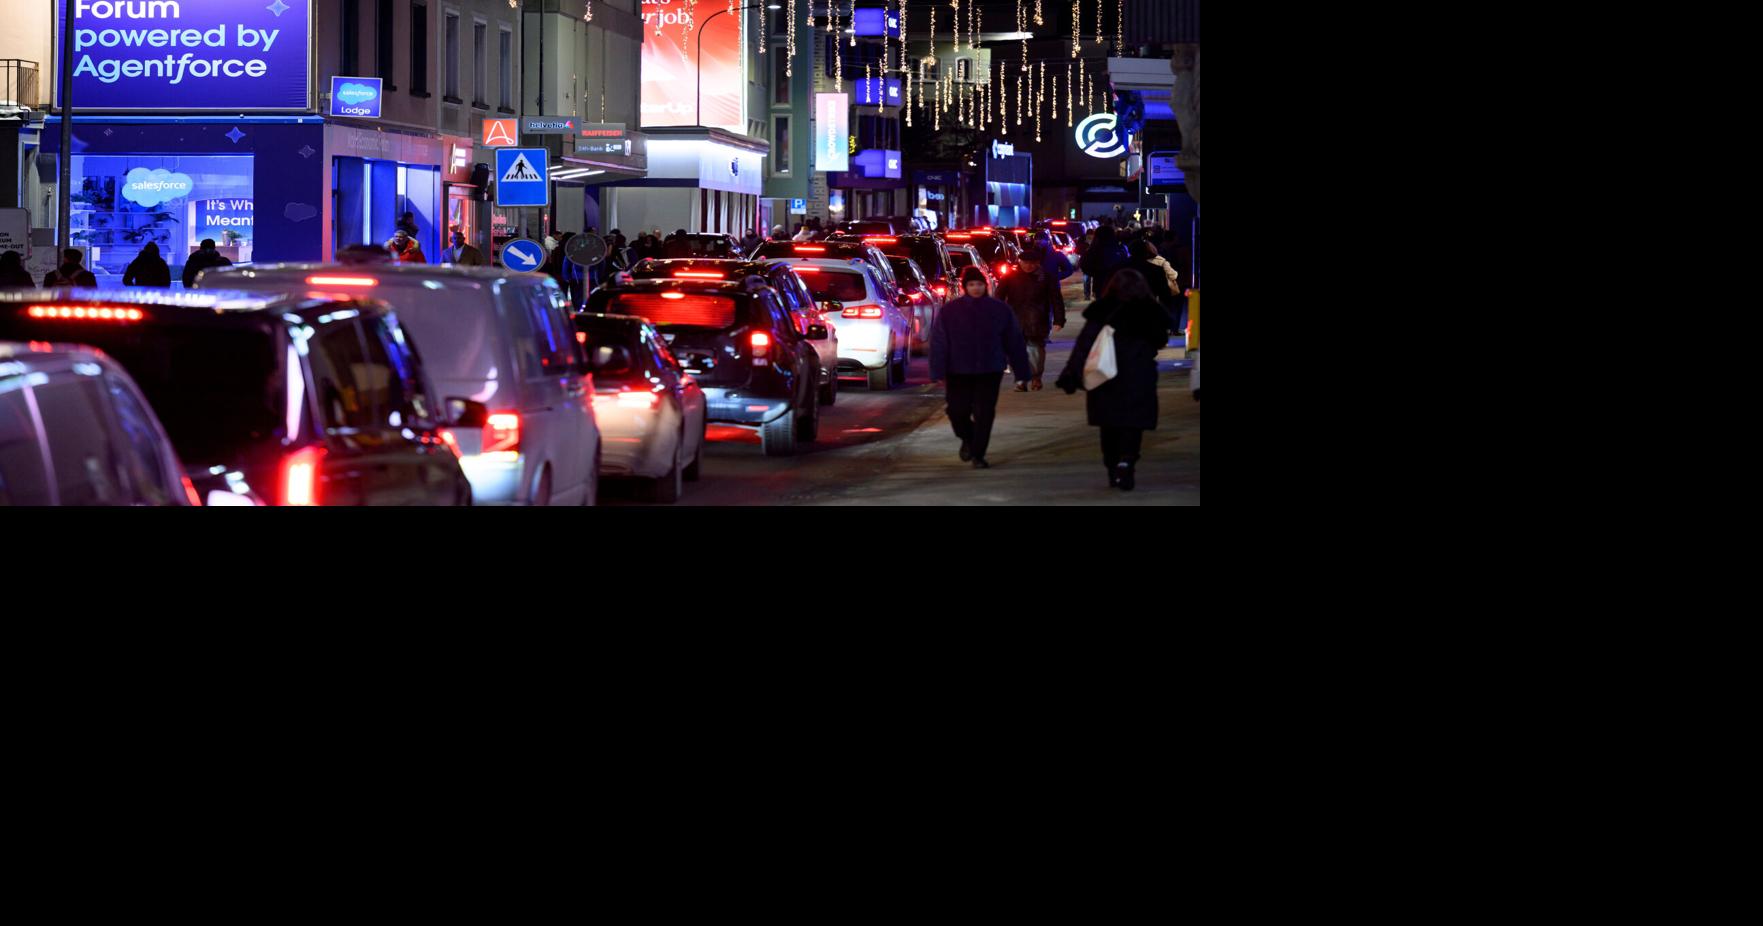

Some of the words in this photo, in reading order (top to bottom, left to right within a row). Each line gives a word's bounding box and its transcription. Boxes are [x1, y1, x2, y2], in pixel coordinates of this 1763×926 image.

[75, 0, 180, 19] Forum
[658, 8, 690, 28] job
[74, 24, 226, 52] powered
[237, 24, 280, 52] by
[72, 53, 267, 84] Agentforce
[341, 106, 371, 116] Lodge
[131, 180, 187, 192] salesforce
